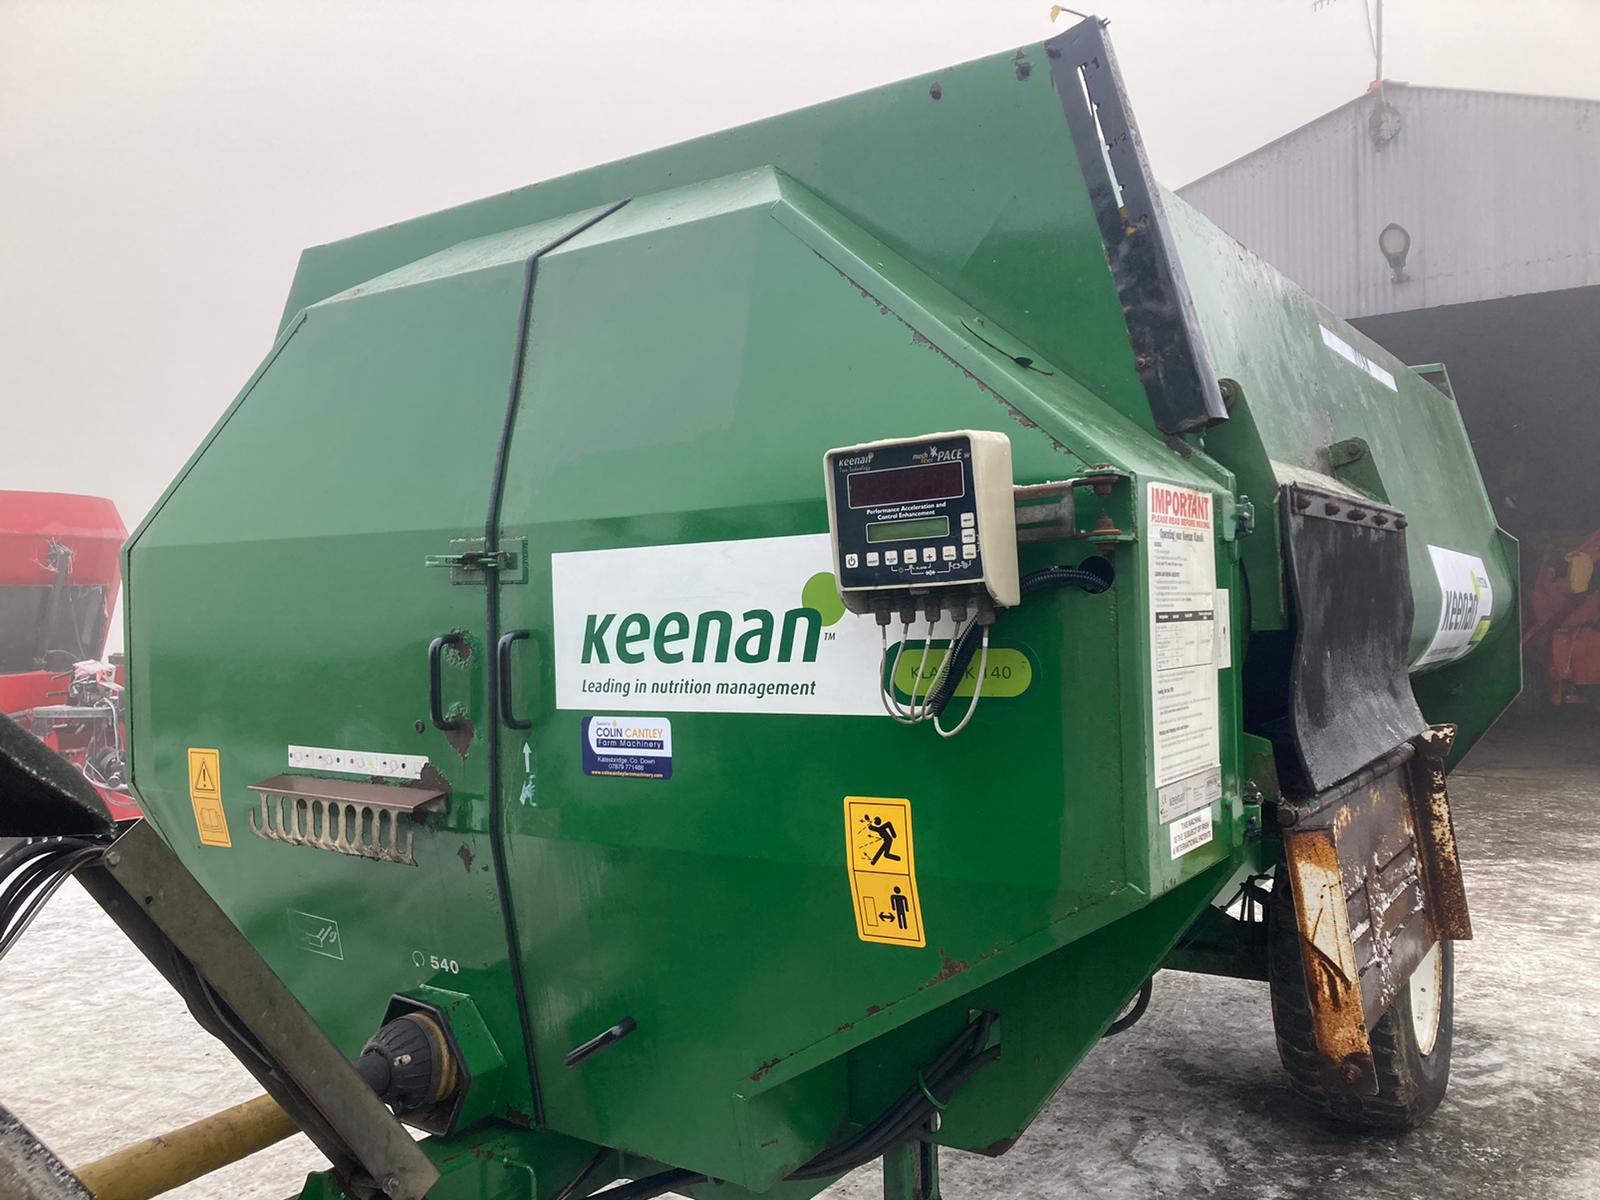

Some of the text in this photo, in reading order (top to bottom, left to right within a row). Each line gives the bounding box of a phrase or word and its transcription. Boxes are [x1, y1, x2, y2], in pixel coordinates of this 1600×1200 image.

[937, 449, 963, 461] PACE
[866, 506, 900, 515] Performance
[901, 503, 935, 511] Acceleration
[1152, 487, 1209, 521] IMPORTANT
[877, 510, 935, 520] Control Enhancement
[911, 666, 976, 680] KLAK
[582, 679, 817, 699] Leading in nutrition management
[596, 727, 663, 739] COLIN CANTLEY
[598, 738, 662, 749] Farm Machinery
[430, 954, 460, 975] 540
